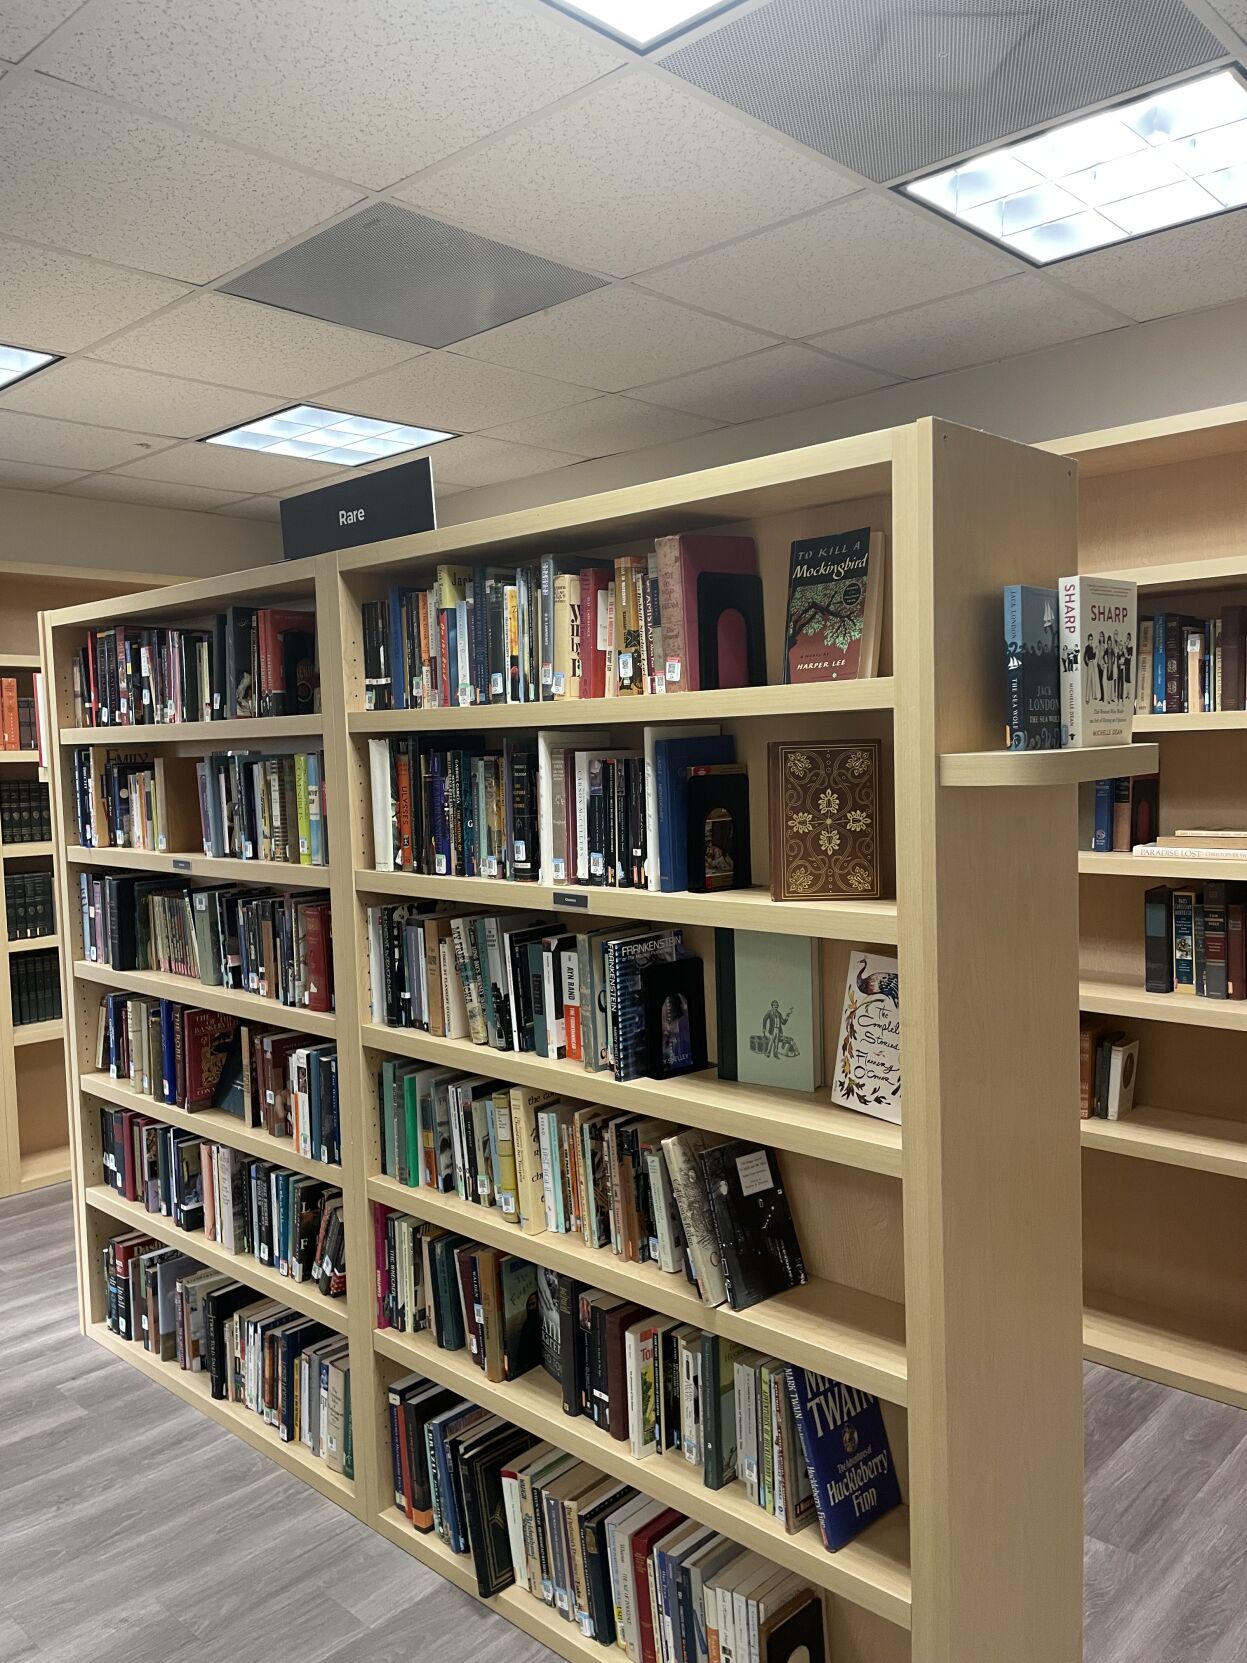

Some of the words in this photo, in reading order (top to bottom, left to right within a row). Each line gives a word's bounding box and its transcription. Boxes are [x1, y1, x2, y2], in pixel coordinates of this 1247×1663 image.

[338, 508, 365, 526] Rare
[798, 551, 813, 561] TO
[818, 544, 847, 557] KILL
[853, 541, 861, 550] A
[792, 553, 868, 579] Mockingbird
[1064, 584, 1076, 634] SHARP
[1090, 604, 1128, 624] SHARP
[796, 660, 830, 670] HARPER
[832, 659, 846, 667] LEE
[401, 786, 409, 825] ULYSSES
[1139, 848, 1179, 857] PARADISE
[1180, 849, 1201, 858] LOST
[452, 926, 462, 941] MY
[622, 936, 682, 957] FRANKENSTEIN
[566, 966, 574, 980] AYN
[607, 943, 617, 1012] FRANKENSTEIN
[567, 982, 575, 1001] RAND
[876, 1005, 889, 1020] The
[857, 1015, 901, 1037] Complet
[472, 1270, 480, 1298] WALDEN
[640, 1347, 653, 1361] To
[784, 1367, 797, 1391] MARK
[789, 1392, 803, 1419] TWAIN
[428, 1433, 438, 1474] BRAZIL
[807, 1465, 823, 1510] Huckleberry
[827, 1450, 889, 1506] Huckleberry
[519, 1479, 527, 1500] WAUGH
[852, 1487, 877, 1518] Finn
[816, 1512, 827, 1528] Finn
